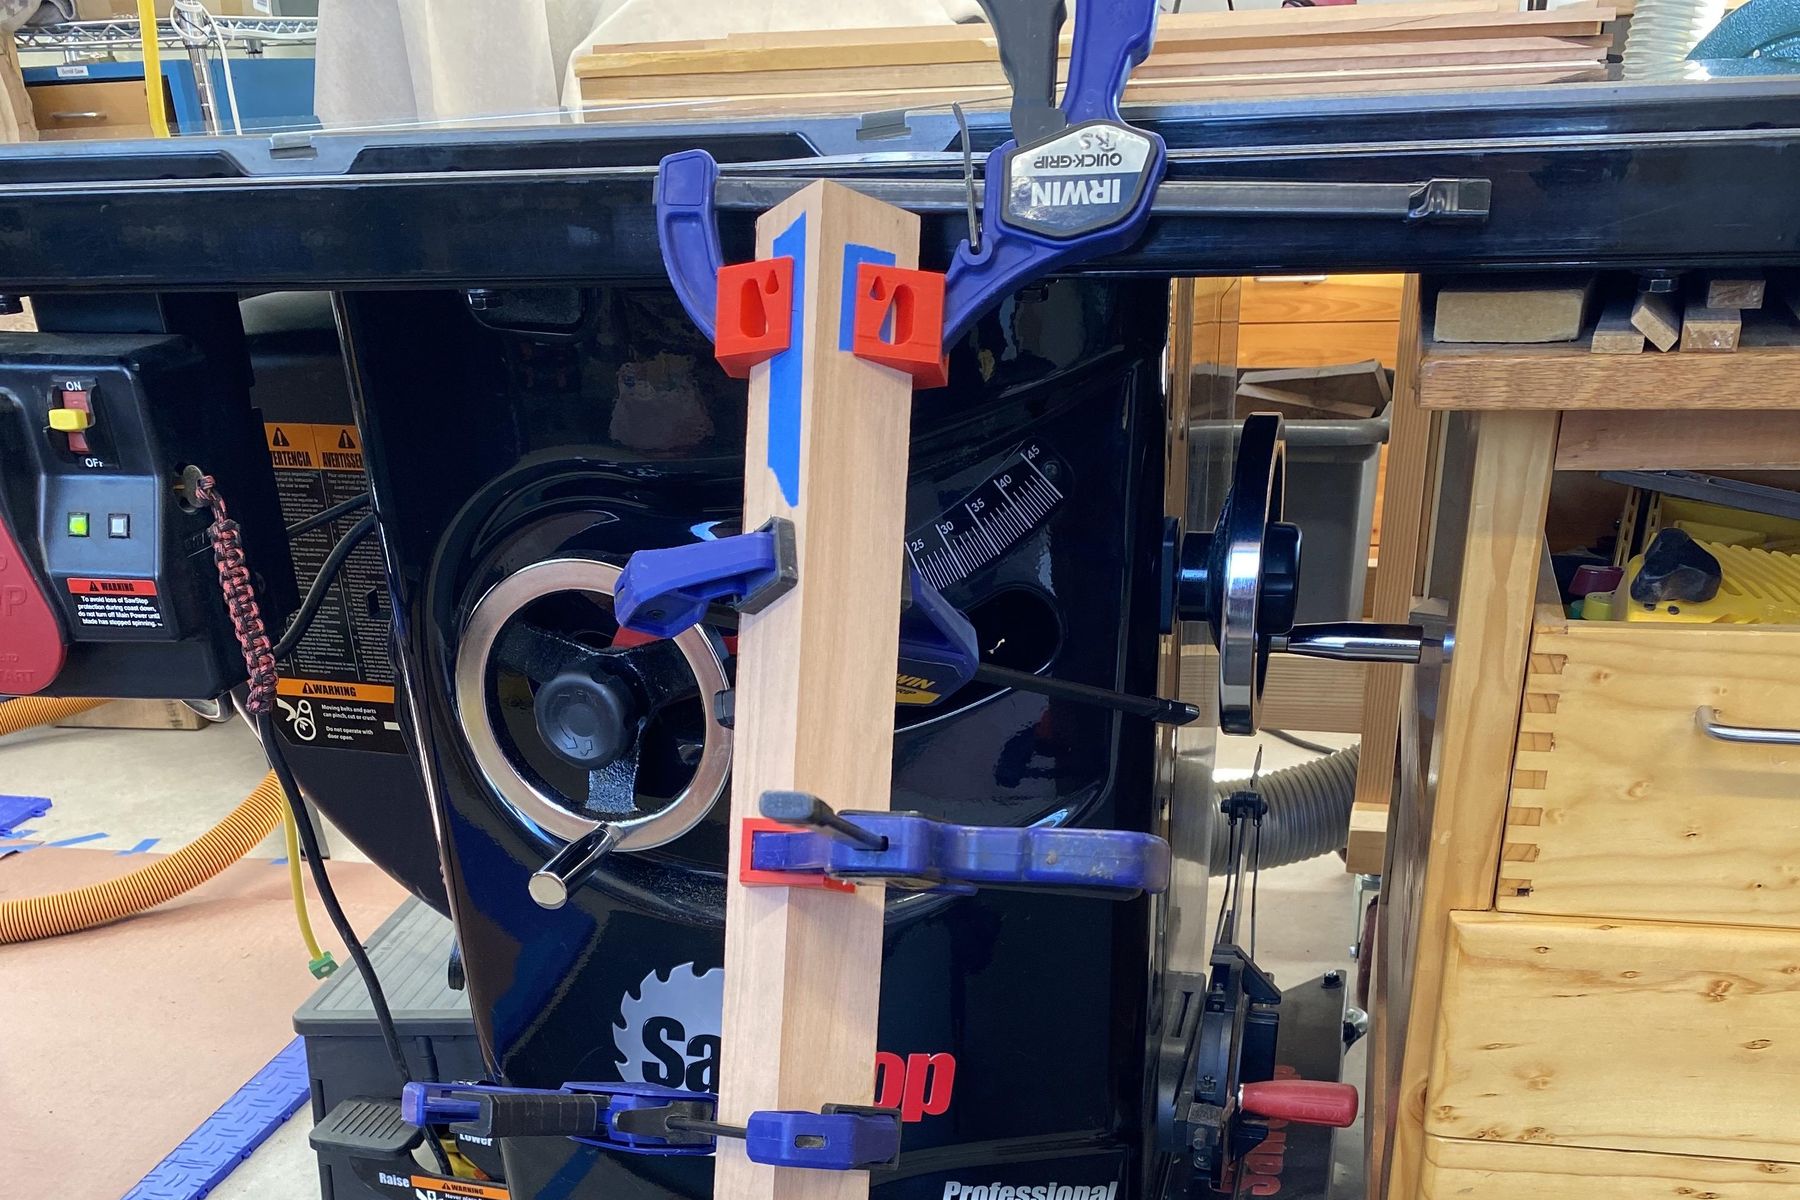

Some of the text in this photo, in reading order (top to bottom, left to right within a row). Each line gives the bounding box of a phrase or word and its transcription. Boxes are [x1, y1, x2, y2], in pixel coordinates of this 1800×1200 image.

[1031, 179, 1120, 207] IRWIN
[65, 381, 82, 391] ON
[271, 450, 313, 467] ERTENCIA
[1027, 444, 1040, 460] 45
[999, 474, 1012, 489] 40
[971, 497, 985, 513] 35
[940, 520, 954, 535] 30
[911, 538, 925, 553] 25
[101, 582, 135, 592] WARNING
[124, 597, 149, 606] SawStop
[109, 619, 131, 627] stopped
[148, 612, 160, 620] until
[897, 674, 936, 690] WIN
[312, 683, 357, 697] WARNING
[321, 704, 340, 712] Moving
[379, 1172, 410, 1188] Raise
[445, 1193, 461, 1200] Never
[451, 1184, 484, 1195] WARNING
